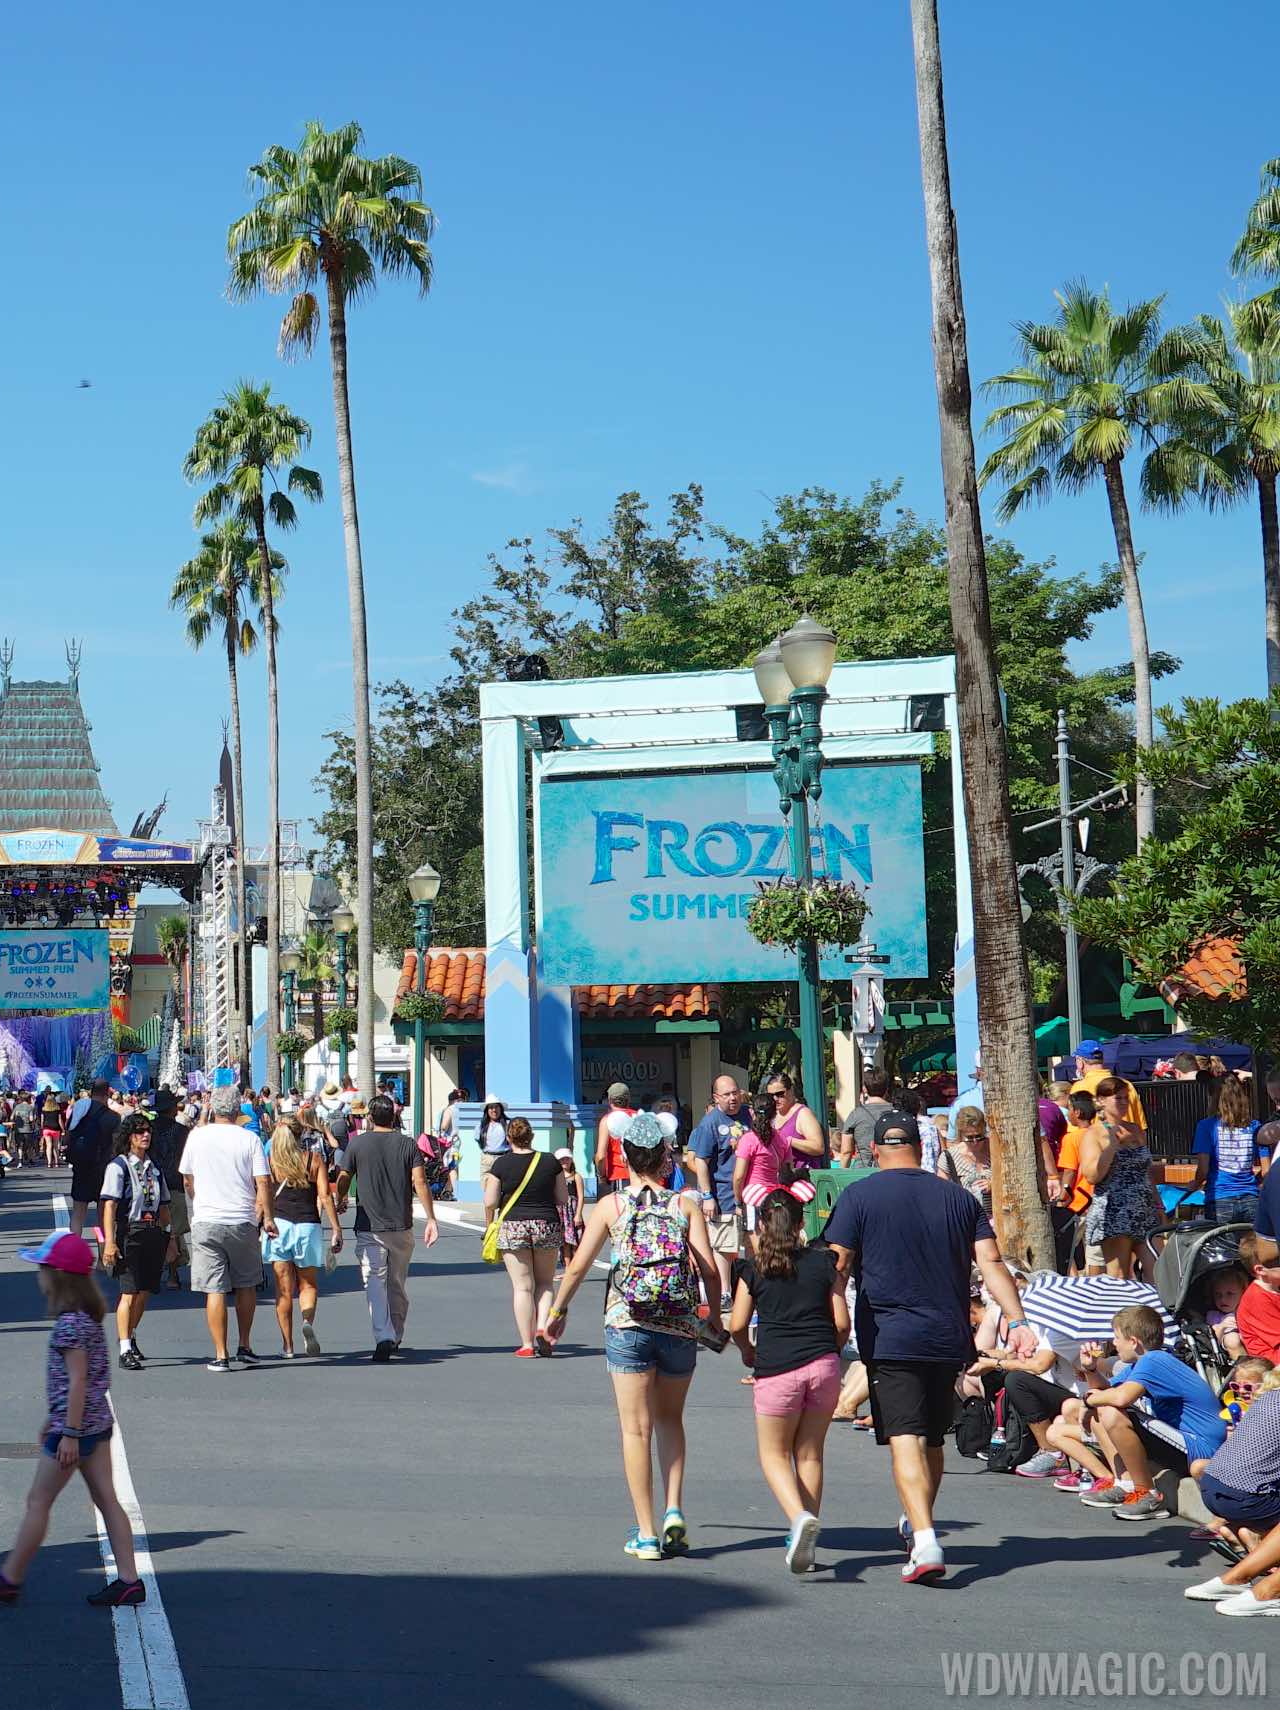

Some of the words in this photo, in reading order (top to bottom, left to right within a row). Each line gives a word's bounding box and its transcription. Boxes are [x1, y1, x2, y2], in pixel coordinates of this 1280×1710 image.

[17, 839, 64, 850] FROZEN
[589, 809, 874, 885] FROZEN
[628, 892, 754, 922] SUMME
[9, 966, 50, 975] SUMMER
[53, 965, 75, 974] FUN
[581, 1060, 660, 1081] LLYWOOD
